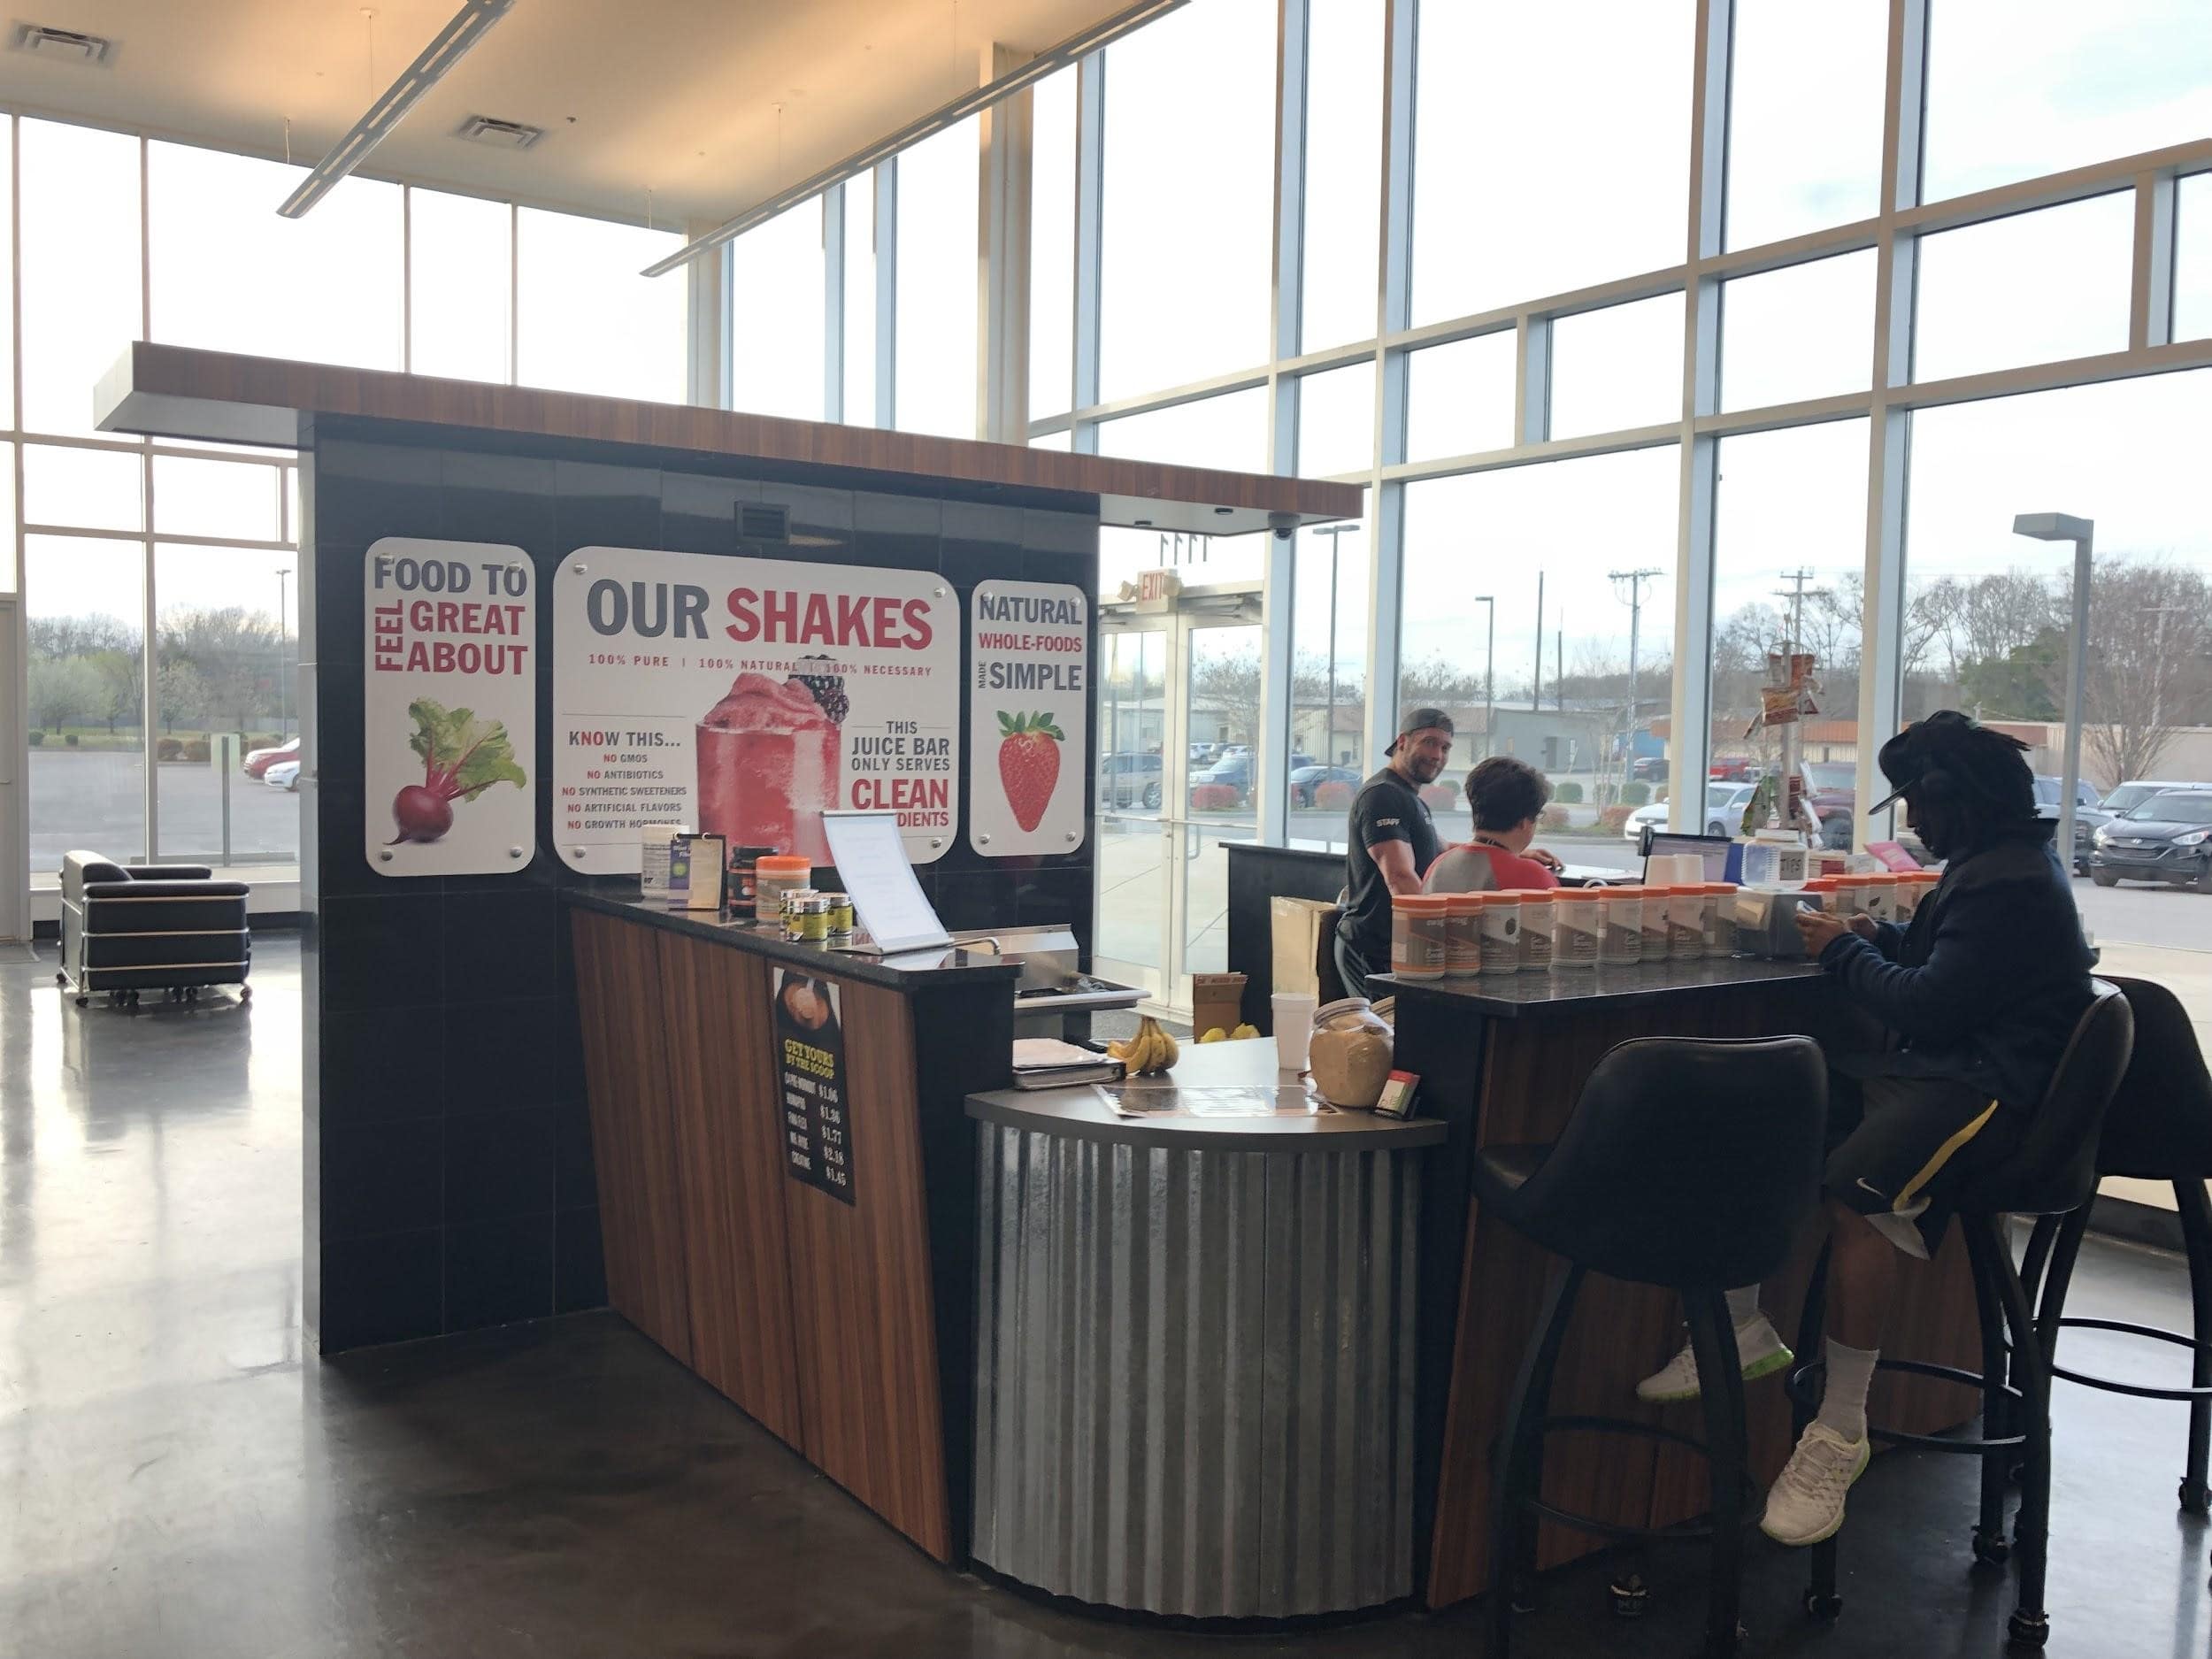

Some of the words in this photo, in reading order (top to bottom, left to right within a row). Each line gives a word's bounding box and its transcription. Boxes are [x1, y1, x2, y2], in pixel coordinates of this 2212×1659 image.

[374, 557, 472, 593] FOOD
[481, 564, 527, 597] TO
[1141, 572, 1164, 602] EXIT
[410, 600, 526, 635] GREAT
[587, 579, 710, 640] OUR
[726, 588, 933, 650] SHAKES
[979, 594, 1083, 625] NATURAL
[374, 599, 403, 672] FEEL
[979, 633, 1082, 652] WHOLE-FOODS
[406, 641, 528, 675] ABOUT
[588, 654, 626, 665] 100%
[634, 656, 669, 666] PURE
[699, 658, 733, 669] 100%
[741, 659, 798, 672] NATURAL
[825, 664, 857, 674] 100%
[864, 665, 933, 677] NECESSARY
[978, 661, 987, 689] MADE
[989, 662, 1082, 691] SIMPLE
[886, 721, 918, 734] THIS
[569, 731, 619, 746] KNOW
[626, 733, 680, 747] THIS...
[852, 737, 906, 756] JUICE
[913, 738, 949, 756] BAR
[603, 754, 617, 763] NO
[620, 754, 648, 763] GMOS
[851, 757, 890, 771] ONLY
[895, 758, 950, 771] SERVES
[588, 771, 601, 780] NO
[603, 771, 664, 780] ANTIBIOTICS
[562, 787, 575, 795] NO
[579, 787, 628, 795] SYNTHETIC
[630, 787, 687, 795] SWEETENERS
[851, 779, 949, 810] CLEAN
[567, 803, 581, 812] NO
[584, 803, 637, 812] ARTIFICIAL
[641, 803, 682, 812] FLAVORS
[567, 820, 581, 829] NO
[584, 819, 626, 829] GROWTH
[896, 811, 949, 827] DIENTS
[1376, 818, 1401, 827] STAFF
